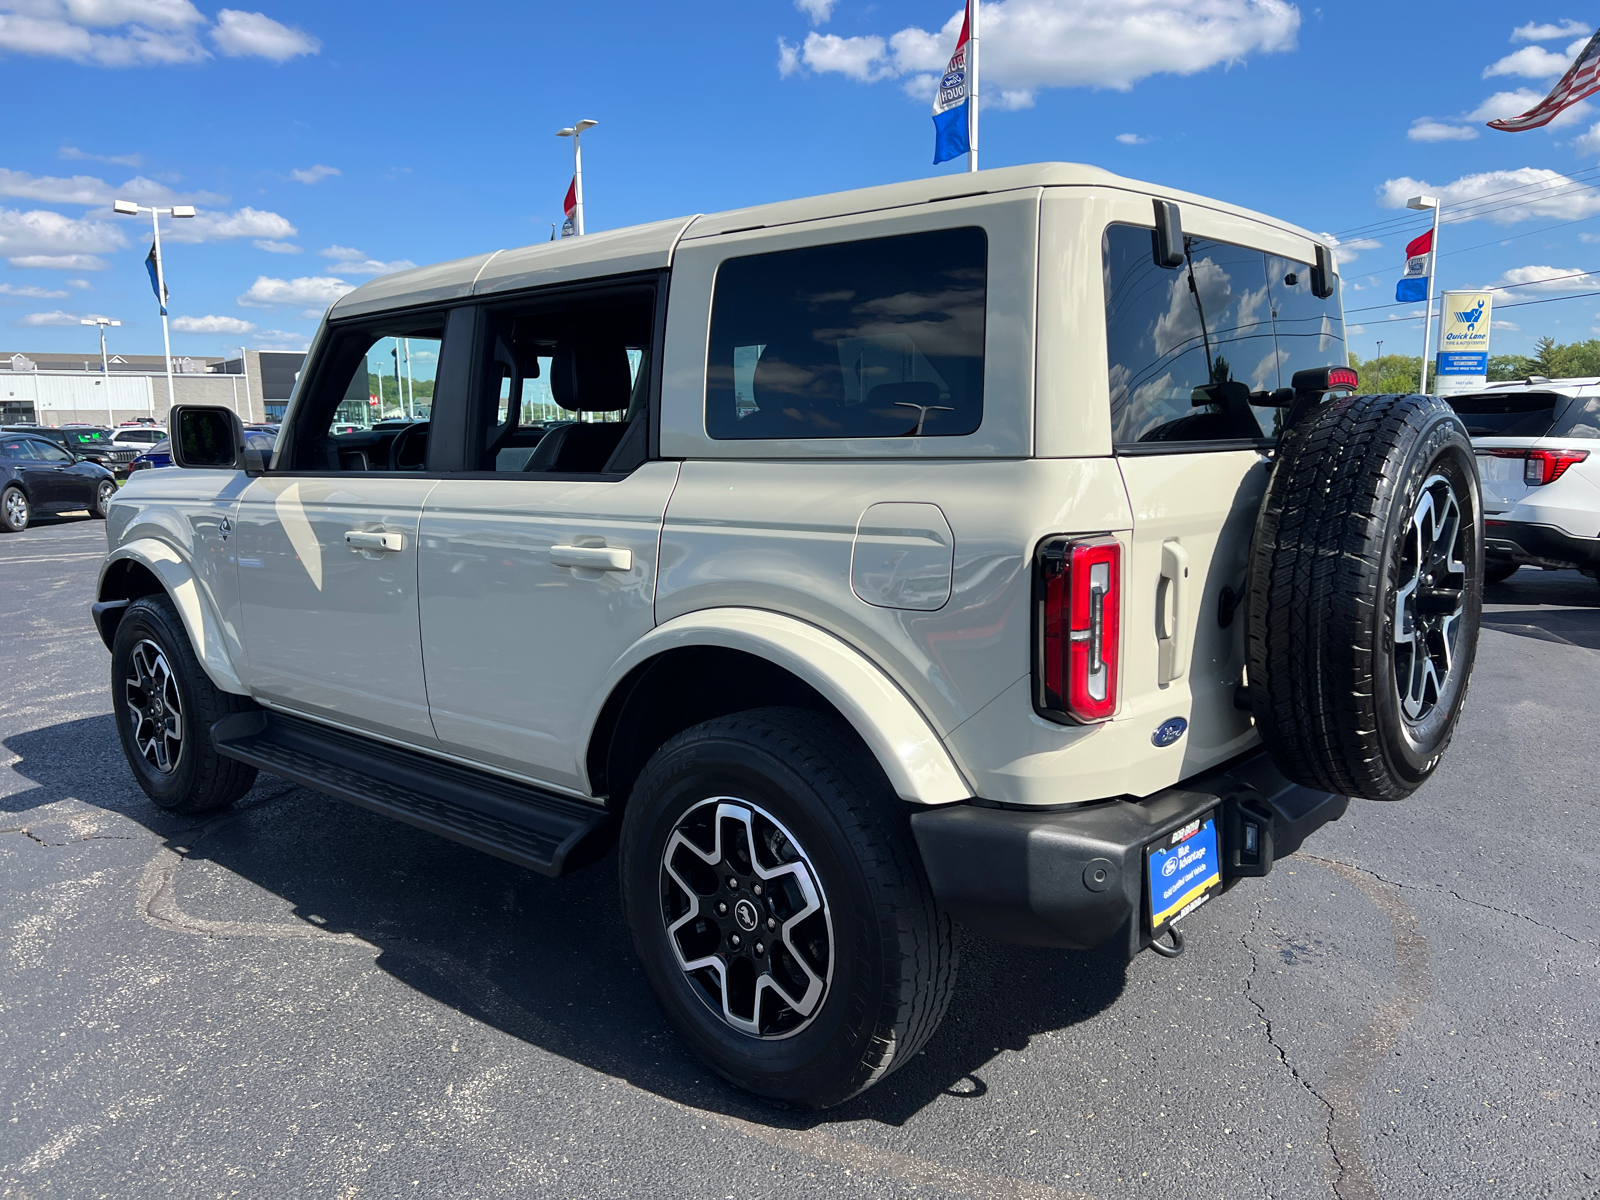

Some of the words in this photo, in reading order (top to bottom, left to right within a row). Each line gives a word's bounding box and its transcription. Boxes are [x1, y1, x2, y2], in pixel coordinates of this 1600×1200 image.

[1446, 332, 1469, 341] Quick
[1469, 332, 1486, 340] Lane
[1178, 844, 1190, 859] Blue
[1179, 847, 1206, 870] Advantage
